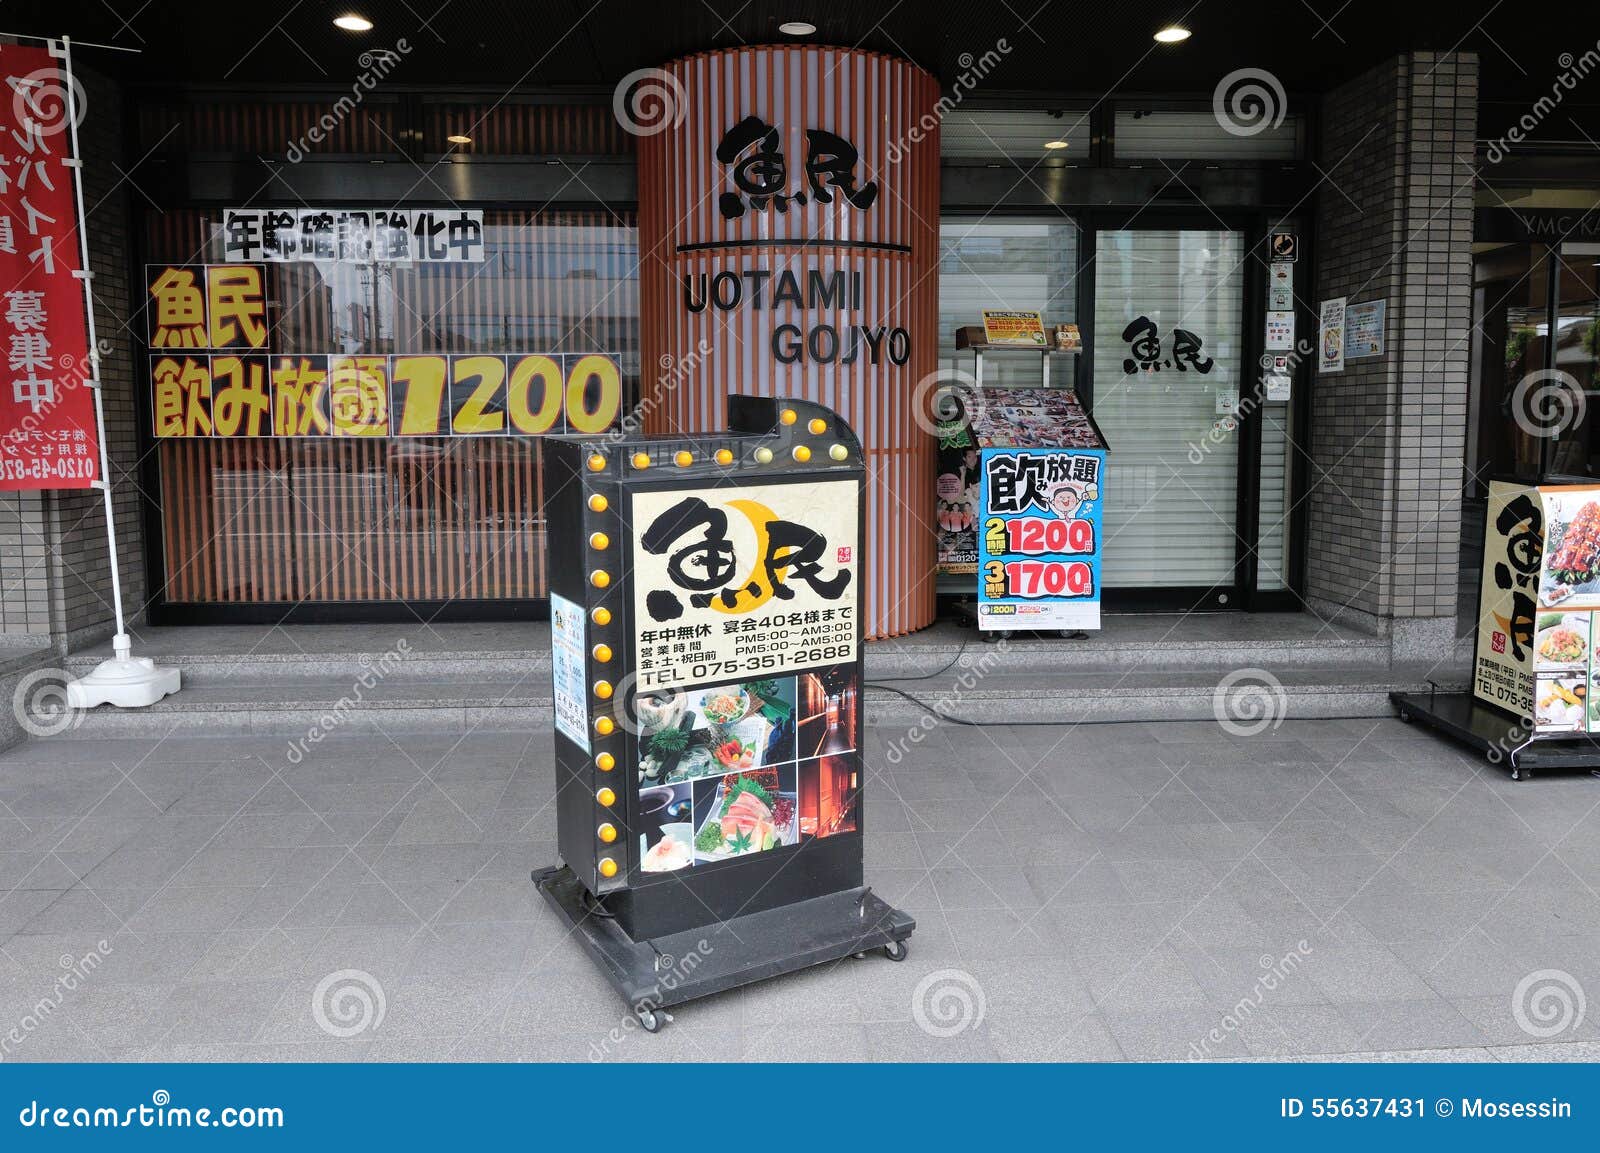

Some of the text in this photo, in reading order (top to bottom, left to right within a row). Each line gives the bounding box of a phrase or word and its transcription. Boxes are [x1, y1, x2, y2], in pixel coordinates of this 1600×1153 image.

[716, 115, 878, 220] 魚民
[225, 211, 482, 260] 年齢確認強化中
[148, 266, 267, 349] 魚民
[684, 269, 861, 314] UOTAMI
[771, 323, 911, 367] GOJYO
[1121, 315, 1214, 374] 魚民
[989, 455, 1098, 512] 飲み放題
[640, 497, 852, 622] 魚民
[640, 606, 853, 645] 年中無休 宴会40名様まで
[640, 640, 702, 659] 営業時間
[640, 645, 851, 685] TEL 075-351-2688
[1477, 678, 1495, 697] TEL
